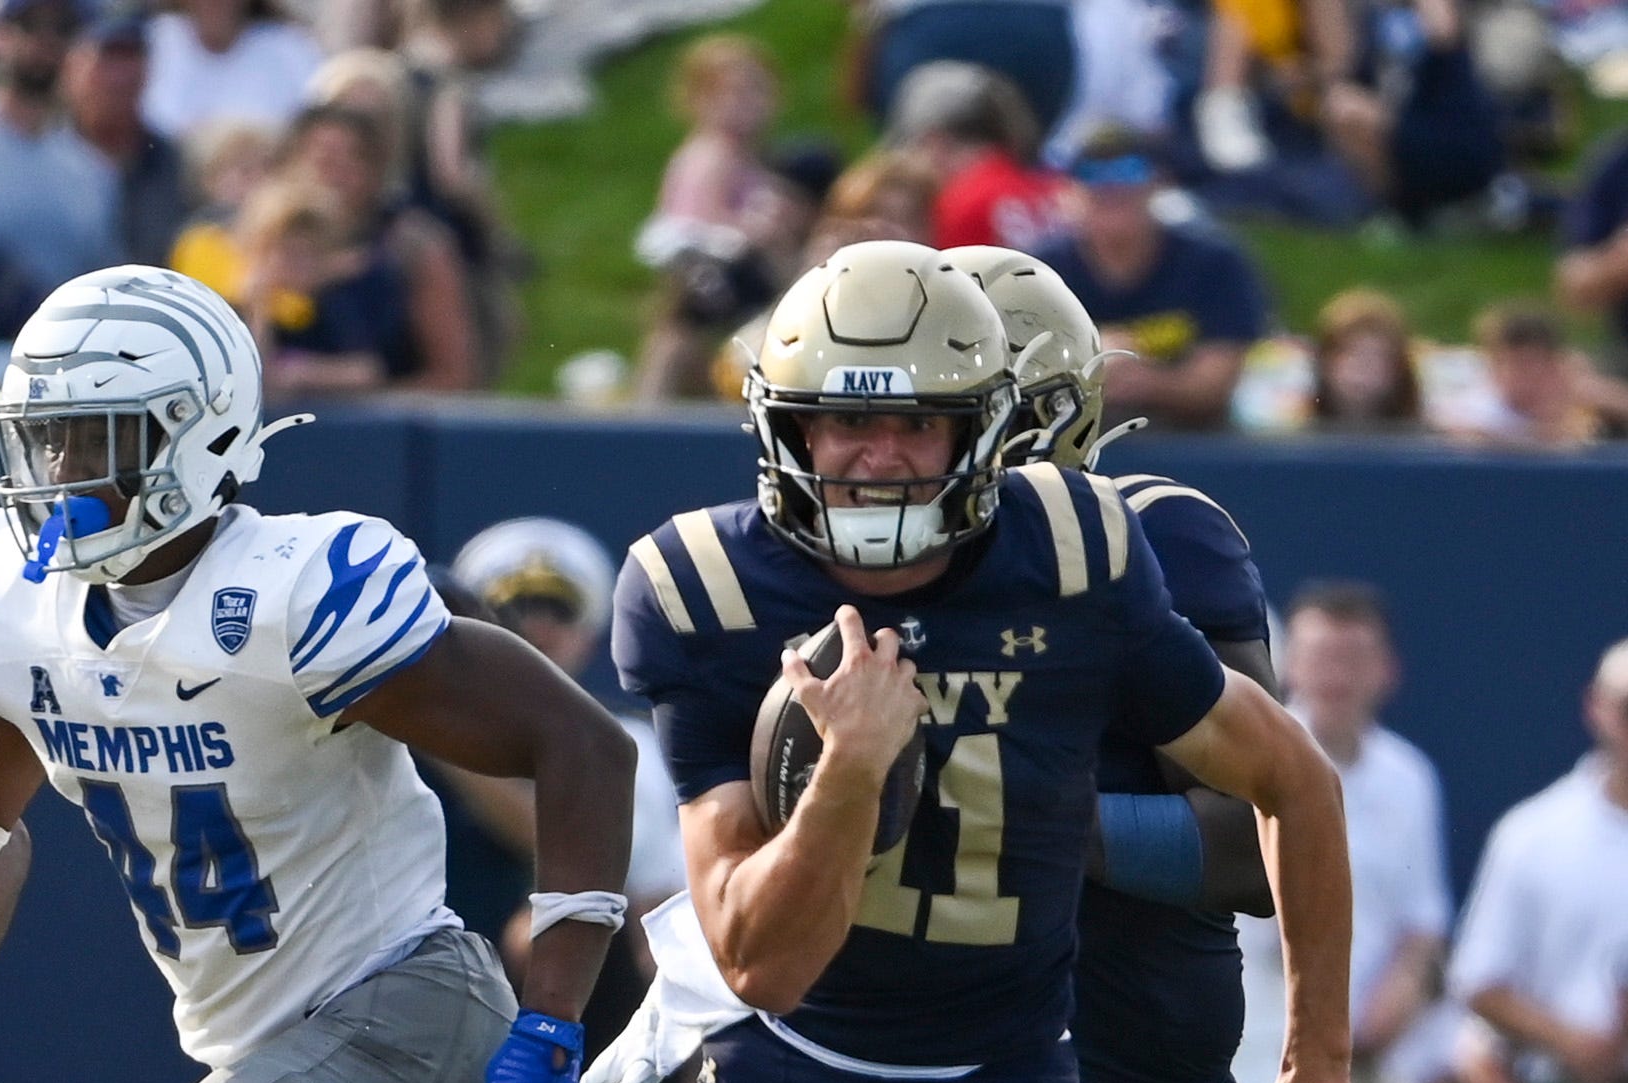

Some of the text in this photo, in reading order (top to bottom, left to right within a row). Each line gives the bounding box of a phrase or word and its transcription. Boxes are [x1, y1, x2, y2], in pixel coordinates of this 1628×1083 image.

[843, 371, 894, 392] NAVY
[915, 671, 1023, 725] VY
[32, 717, 235, 774] MEMPHIS
[779, 737, 795, 783] TEAM
[77, 776, 280, 962] 44
